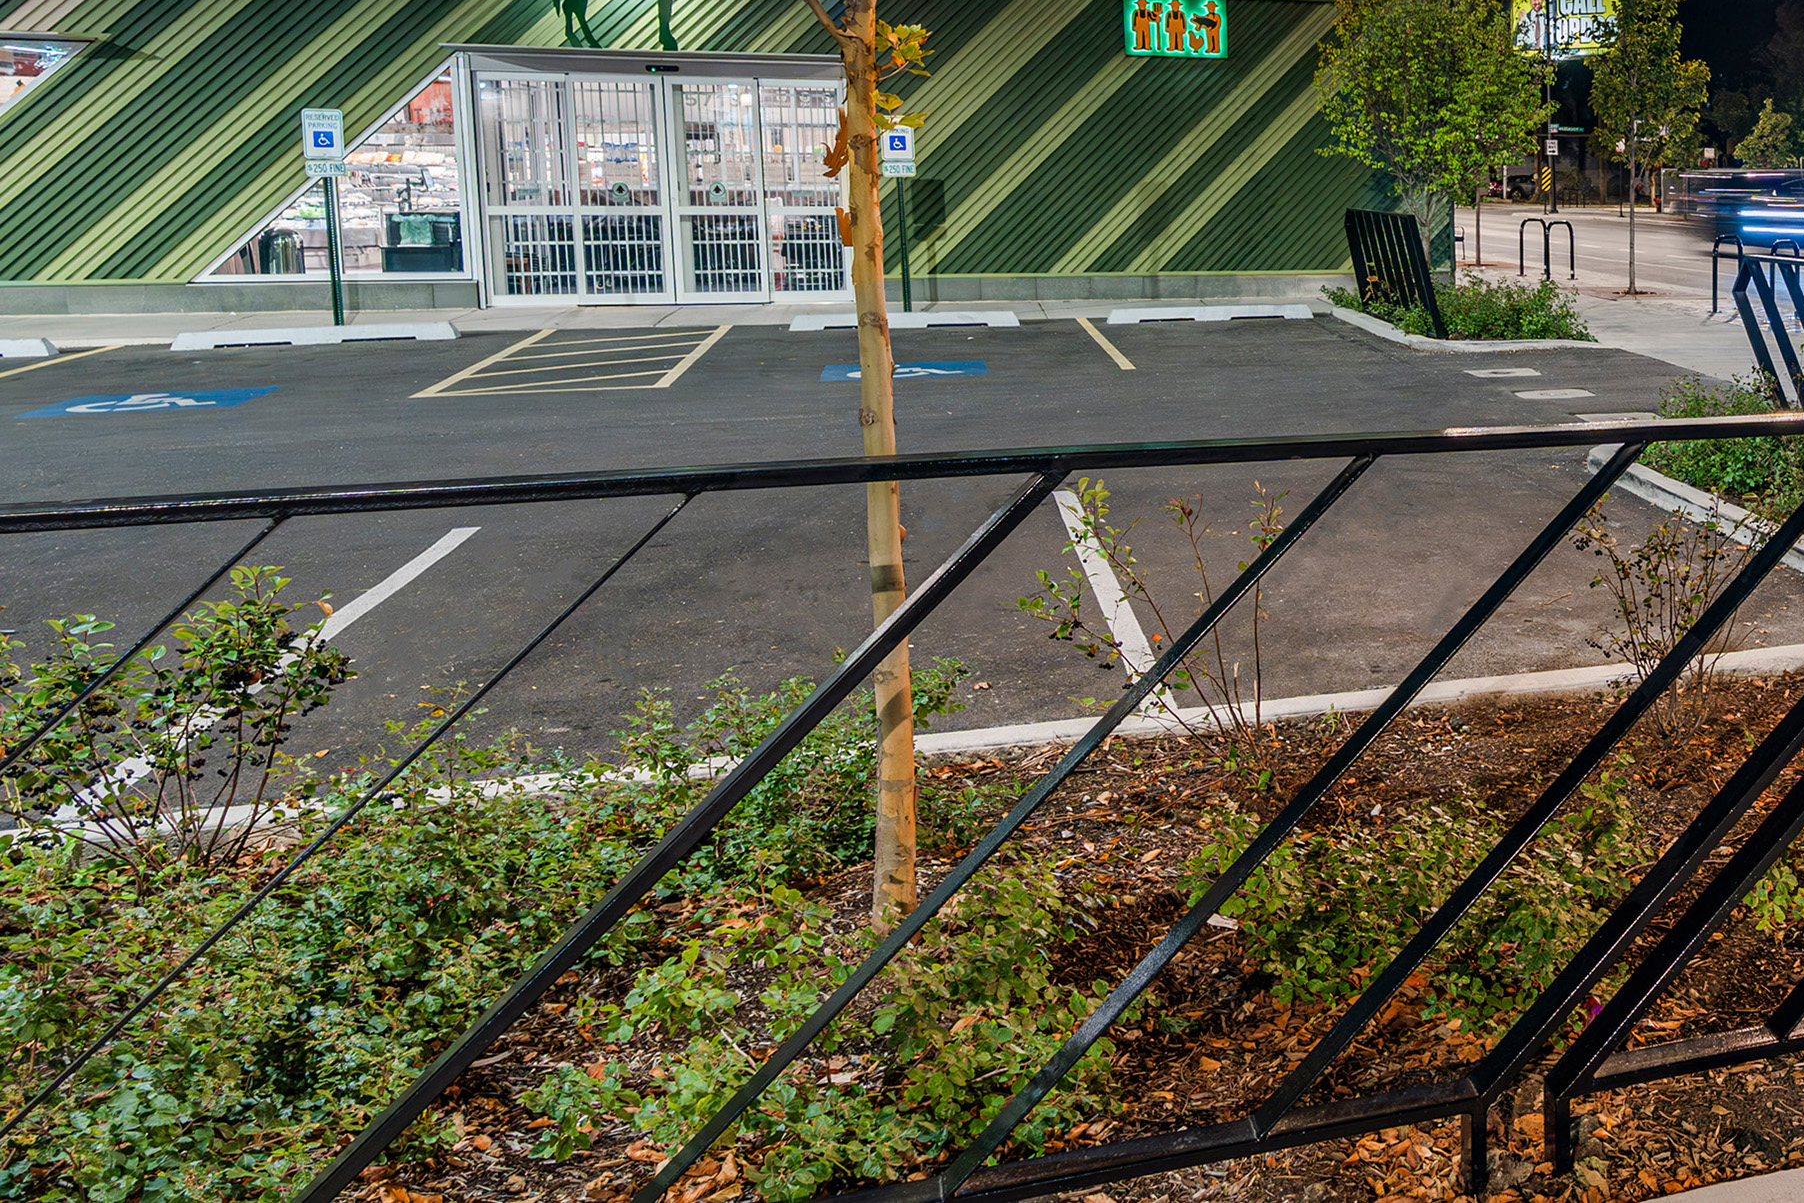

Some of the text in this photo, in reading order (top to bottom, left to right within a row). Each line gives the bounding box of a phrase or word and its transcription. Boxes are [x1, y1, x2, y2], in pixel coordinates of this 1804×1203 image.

[305, 113, 340, 121] RESERVED
[329, 163, 345, 173] FINE
[901, 164, 914, 174] FINE
